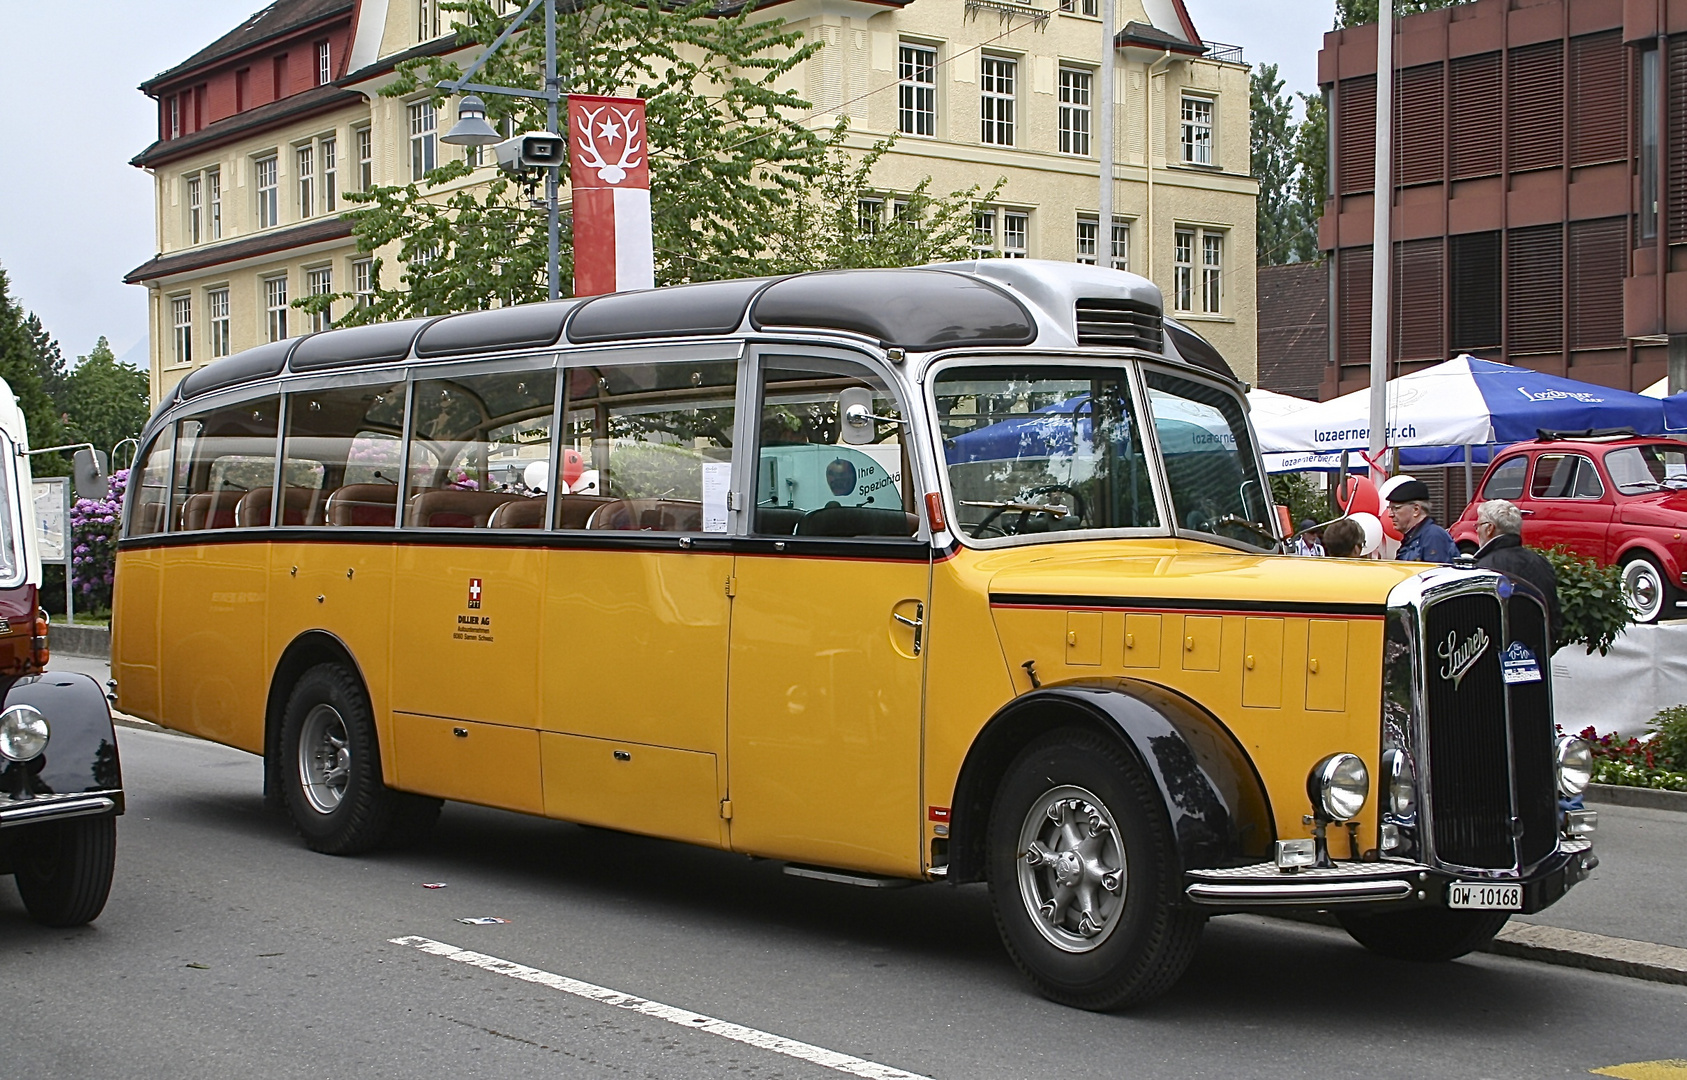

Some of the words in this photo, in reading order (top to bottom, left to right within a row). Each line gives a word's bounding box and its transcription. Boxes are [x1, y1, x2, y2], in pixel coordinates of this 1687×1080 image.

[1192, 432, 1236, 445] lozaerne
[1314, 423, 1416, 443] lozaernerer.ch
[1281, 455, 1342, 468] lozaernerbier.c
[858, 466, 875, 479] Ihre
[859, 471, 901, 497] Spezialitä
[469, 600, 480, 608] PTT
[457, 615, 479, 625] DILLIER
[481, 617, 490, 626] AG
[1438, 627, 1490, 691] Saurer
